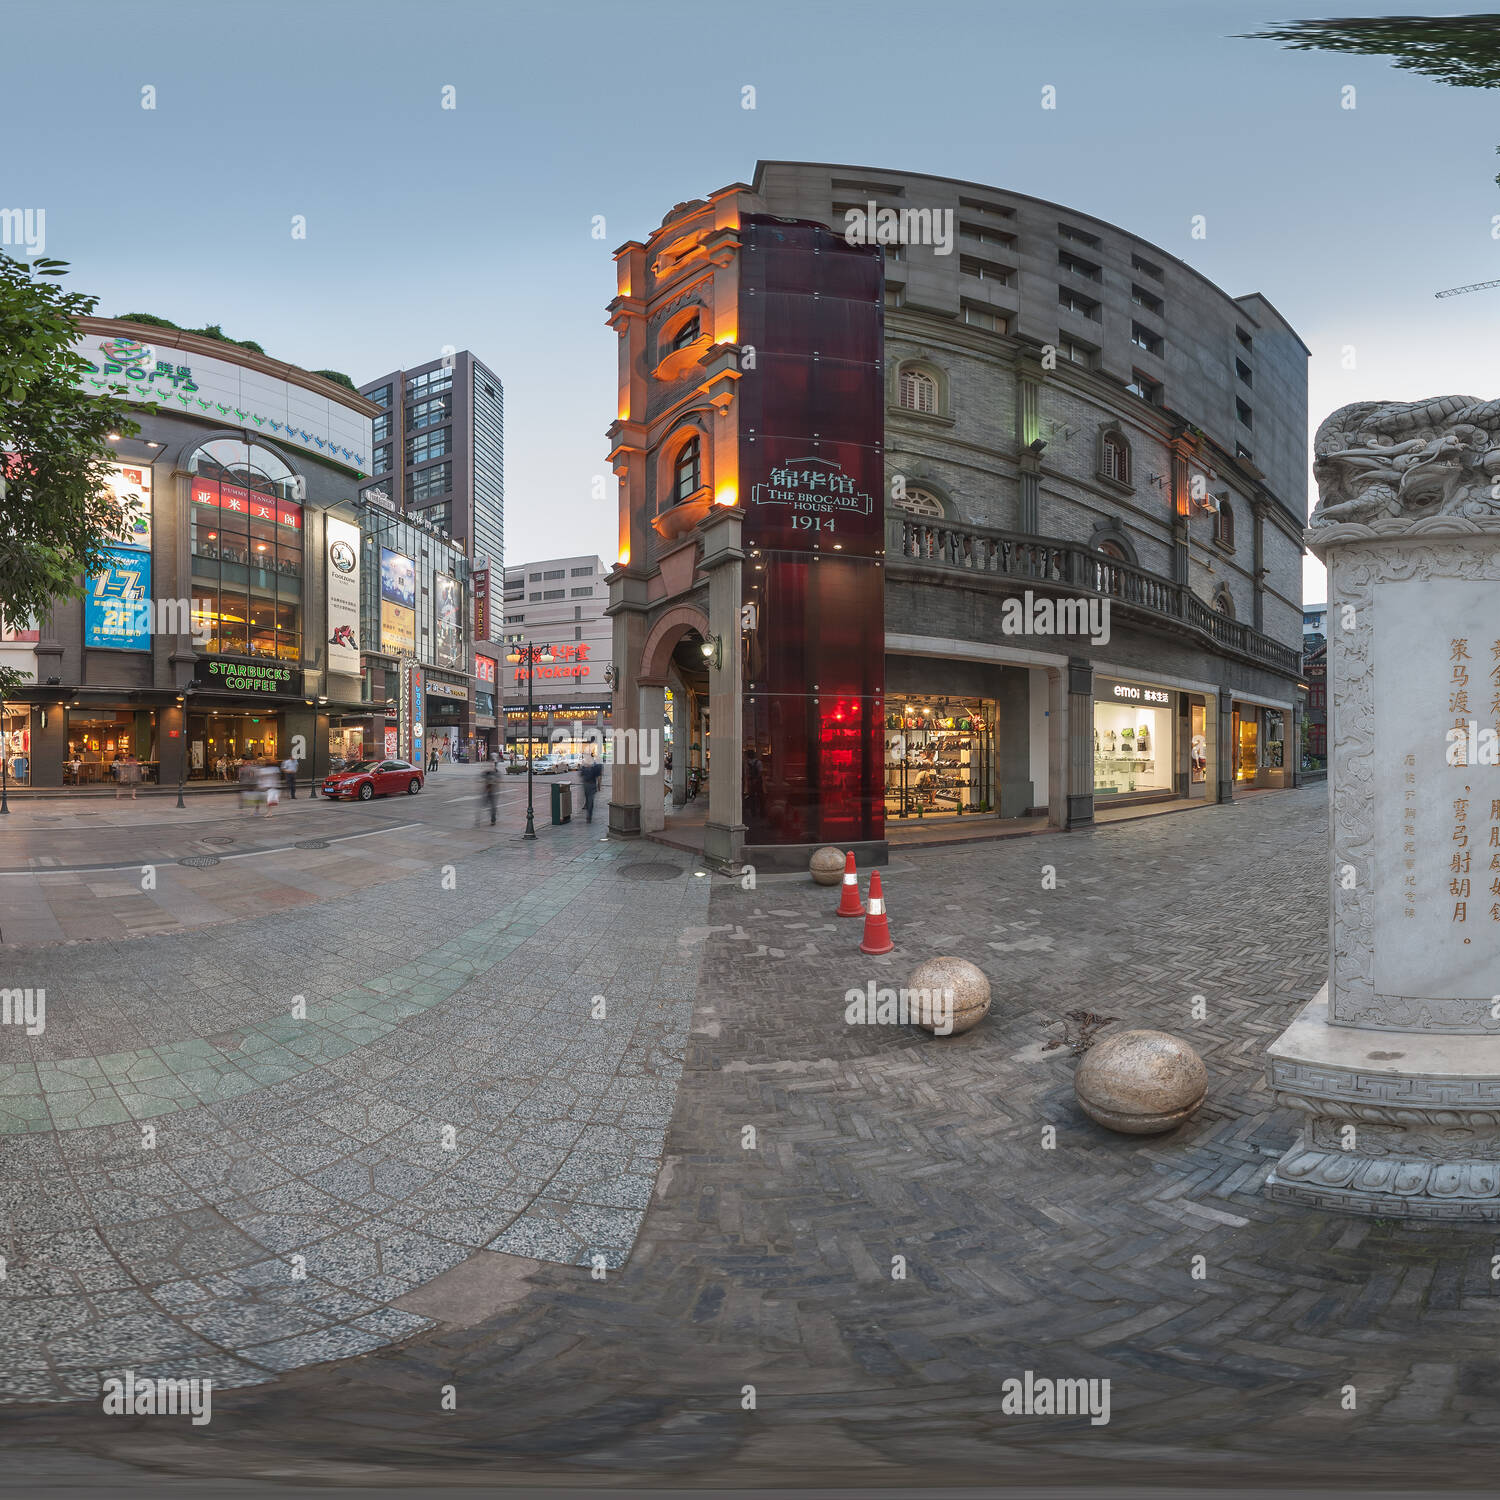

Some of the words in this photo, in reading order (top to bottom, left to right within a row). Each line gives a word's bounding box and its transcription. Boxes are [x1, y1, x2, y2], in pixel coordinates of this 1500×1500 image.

[769, 467, 857, 495] 锦华馆
[222, 486, 248, 497] YUMMY
[252, 494, 276, 506] TANGO
[768, 489, 796, 501] THE
[798, 492, 859, 508] BROCADE
[197, 491, 296, 527] 亚米天阁
[794, 502, 834, 513] HOUSE
[791, 515, 835, 532] 1914
[103, 610, 132, 626] 2F
[209, 661, 291, 681] STARBUCKS
[536, 664, 591, 679] Yokado
[226, 677, 277, 692] COFFEE
[1114, 685, 1141, 699] emoi
[1144, 690, 1169, 703] 基本生活
